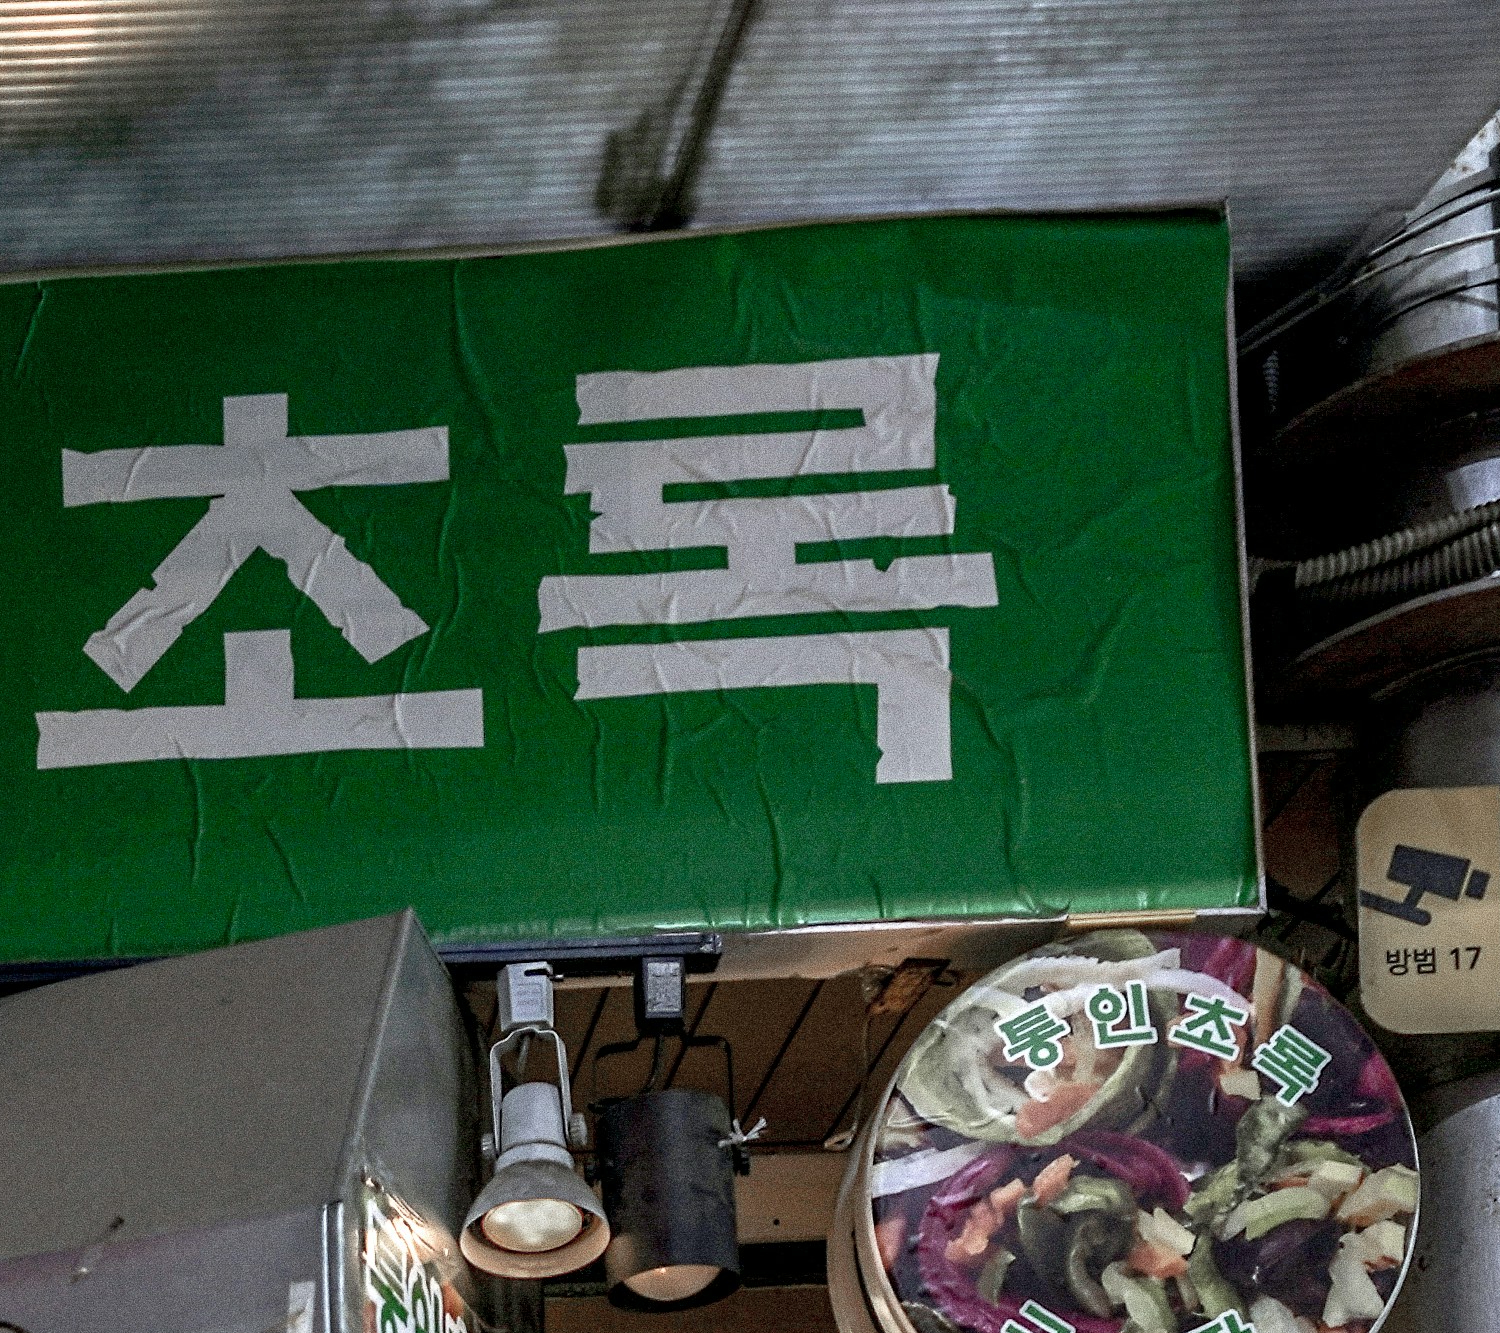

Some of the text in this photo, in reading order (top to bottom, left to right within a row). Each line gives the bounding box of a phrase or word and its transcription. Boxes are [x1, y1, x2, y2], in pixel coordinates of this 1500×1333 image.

[1386, 946, 1481, 976] 방범 17
[994, 980, 1332, 1108] 통인초록
